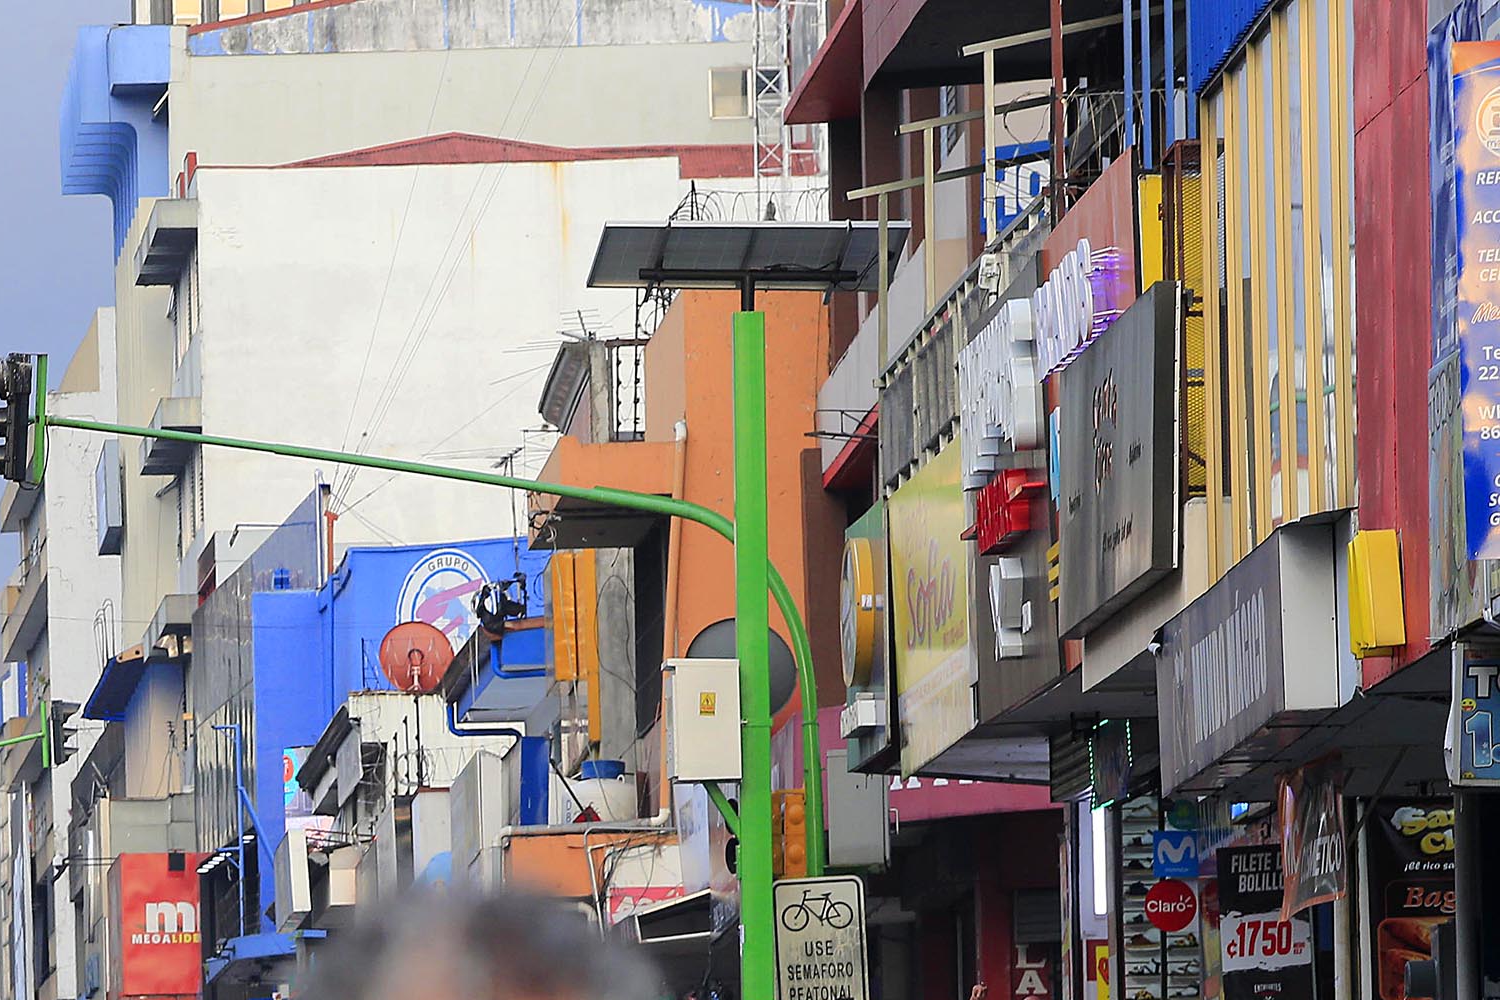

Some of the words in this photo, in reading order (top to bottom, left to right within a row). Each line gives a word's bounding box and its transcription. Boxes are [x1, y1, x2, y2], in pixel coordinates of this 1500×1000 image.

[427, 556, 470, 573] GRUPO
[1191, 622, 1228, 745] MUNDO
[1231, 852, 1272, 873] FILETE
[1146, 896, 1188, 913] Claro
[804, 940, 834, 957] USE
[787, 961, 854, 981] SEMAFORO
